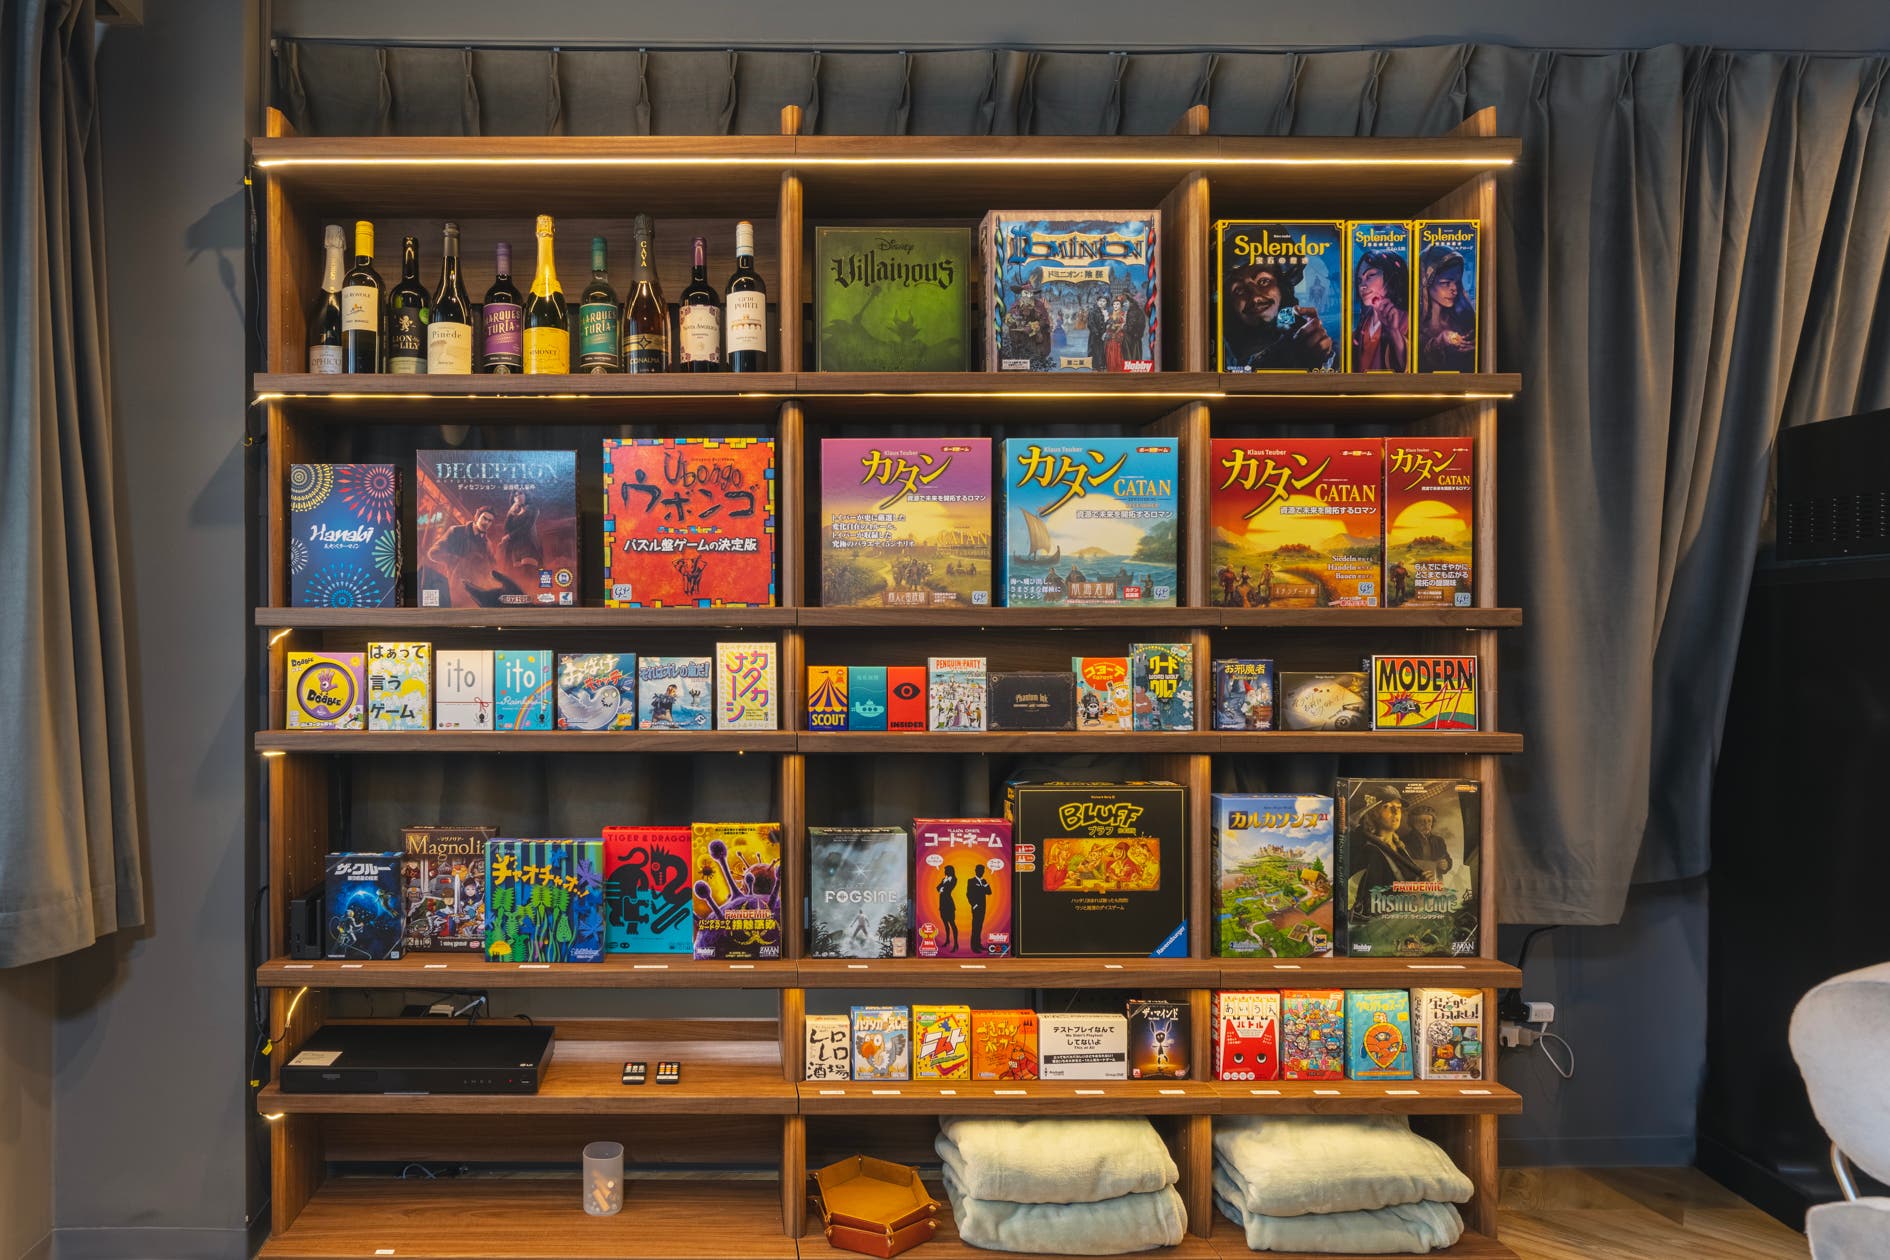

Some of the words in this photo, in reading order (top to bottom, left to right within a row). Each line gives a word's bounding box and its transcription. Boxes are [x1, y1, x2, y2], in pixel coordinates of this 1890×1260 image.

[875, 237, 915, 255] Disney
[1356, 229, 1406, 247] Splendor
[1423, 228, 1474, 247] Splendor
[1234, 229, 1331, 266] Splendor
[831, 250, 954, 290] Villainous
[436, 463, 559, 480] DECEPTION
[664, 450, 742, 490] Ubongo
[1390, 448, 1456, 491] カタン
[861, 449, 952, 510] カタン
[1017, 445, 1128, 517] カタン
[1114, 479, 1171, 497] CATAN
[1220, 449, 1331, 520] カタン
[1438, 475, 1471, 486] CATAN
[621, 469, 761, 522] ウボンゴ
[1315, 484, 1376, 502] CATAN
[310, 523, 374, 544] Hanabi
[624, 538, 758, 552] パズル盤ゲームの決定版
[370, 645, 426, 659] はぁって
[1150, 656, 1179, 674] ワード
[1225, 664, 1265, 674] お邪魔者
[370, 675, 401, 690] 言う
[447, 658, 476, 693] ito
[506, 658, 535, 693] ito
[1379, 660, 1472, 691] MODERN
[371, 703, 415, 719] ゲーム
[812, 714, 846, 726] SCOUT
[1059, 802, 1144, 831] BLUFF
[1230, 810, 1318, 829] カルカソンヌ
[608, 834, 639, 842] TIGER
[1088, 826, 1113, 835] ブラフ
[924, 833, 1003, 848] コードネーム
[334, 863, 391, 875] ザ・クルー
[1393, 880, 1444, 892] PANDEMIC
[1156, 925, 1186, 955] Ravensburger
[1142, 1007, 1178, 1019] ザ・マインド
[807, 1062, 850, 1080] 酒場
